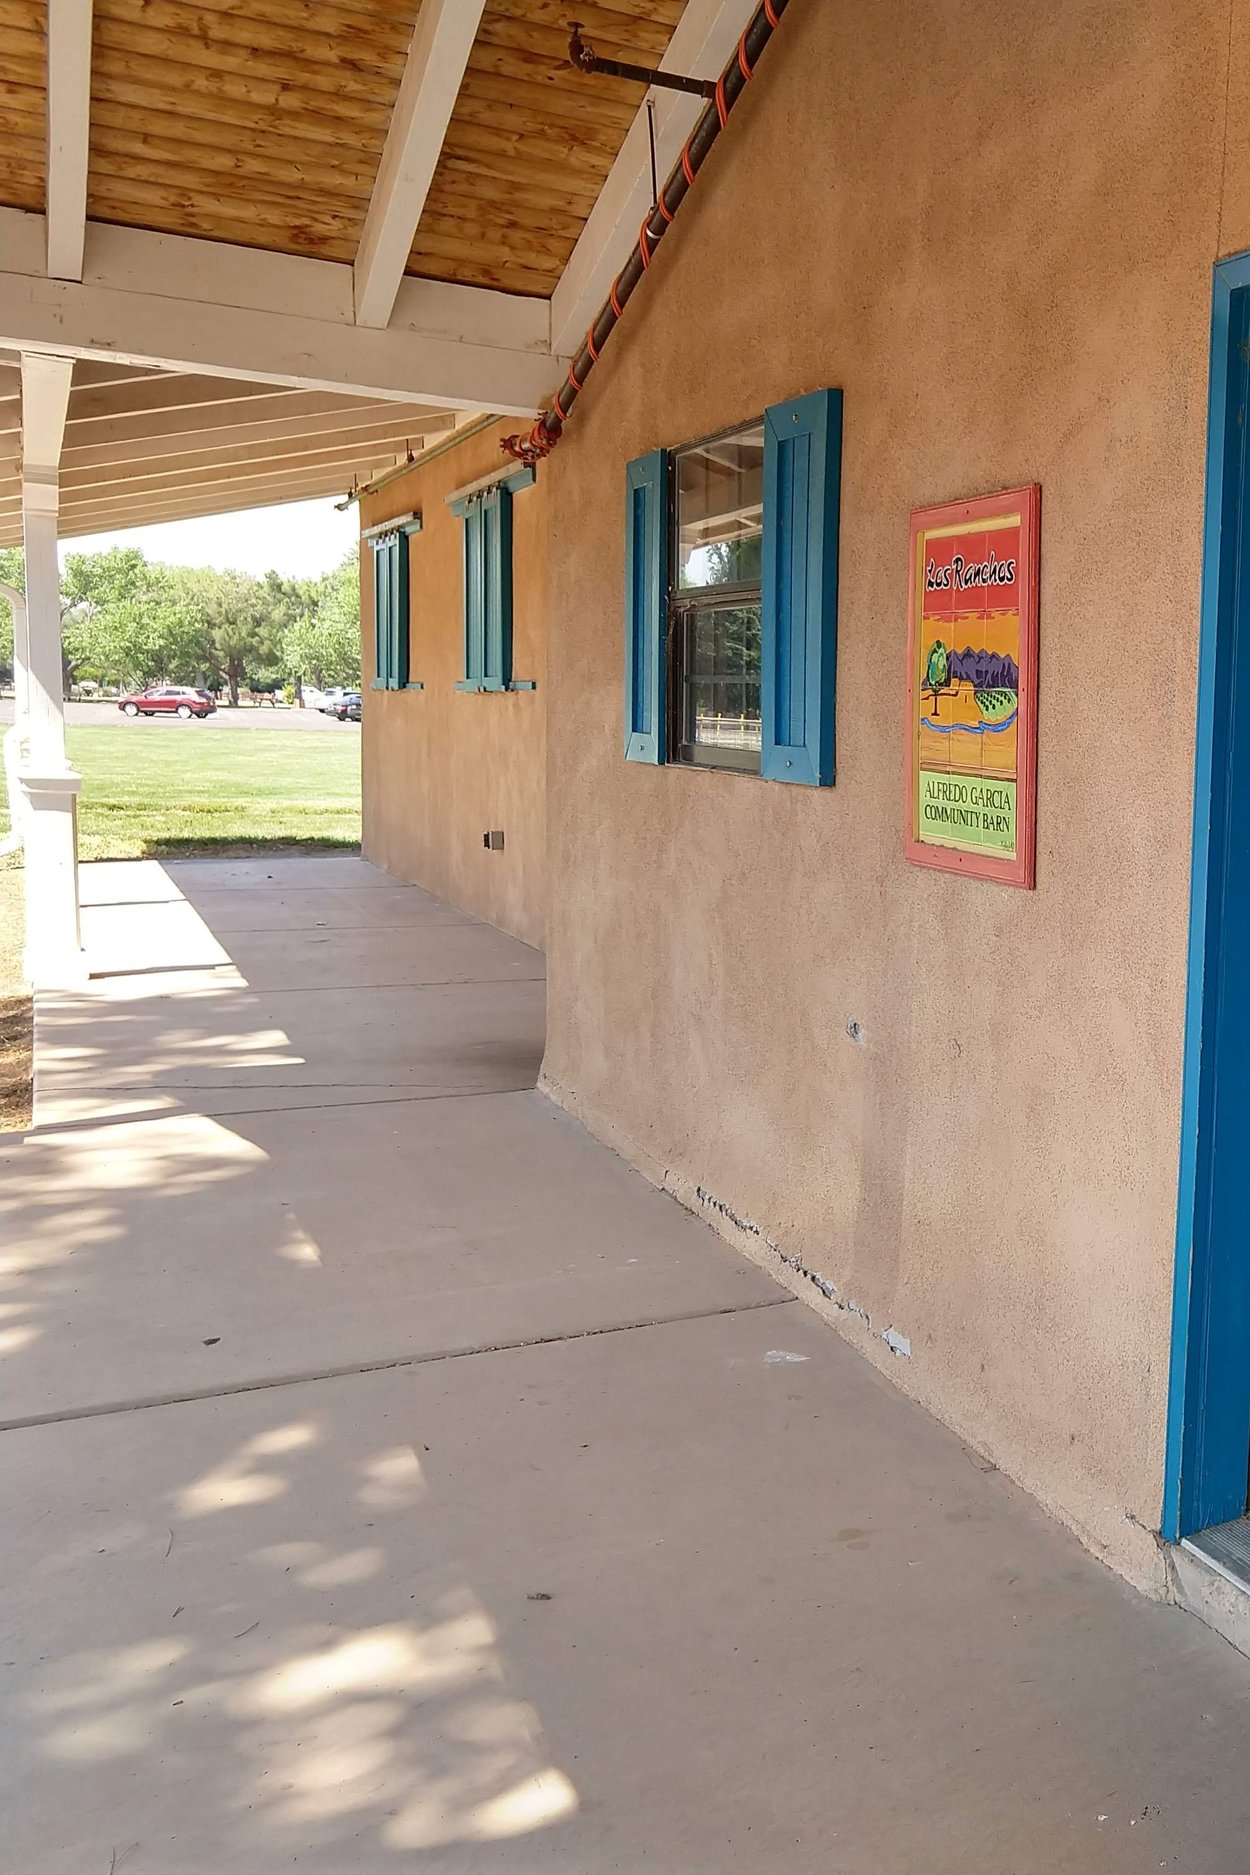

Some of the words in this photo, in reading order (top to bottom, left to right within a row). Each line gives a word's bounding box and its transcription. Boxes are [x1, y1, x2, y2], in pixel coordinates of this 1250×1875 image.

[927, 558, 951, 591] Los
[952, 550, 1016, 591] Ranchos
[924, 780, 968, 804] ALFREDO
[970, 786, 1012, 811] GARCIA
[924, 804, 981, 828] COMMUNITY
[982, 813, 1010, 833] BARN
